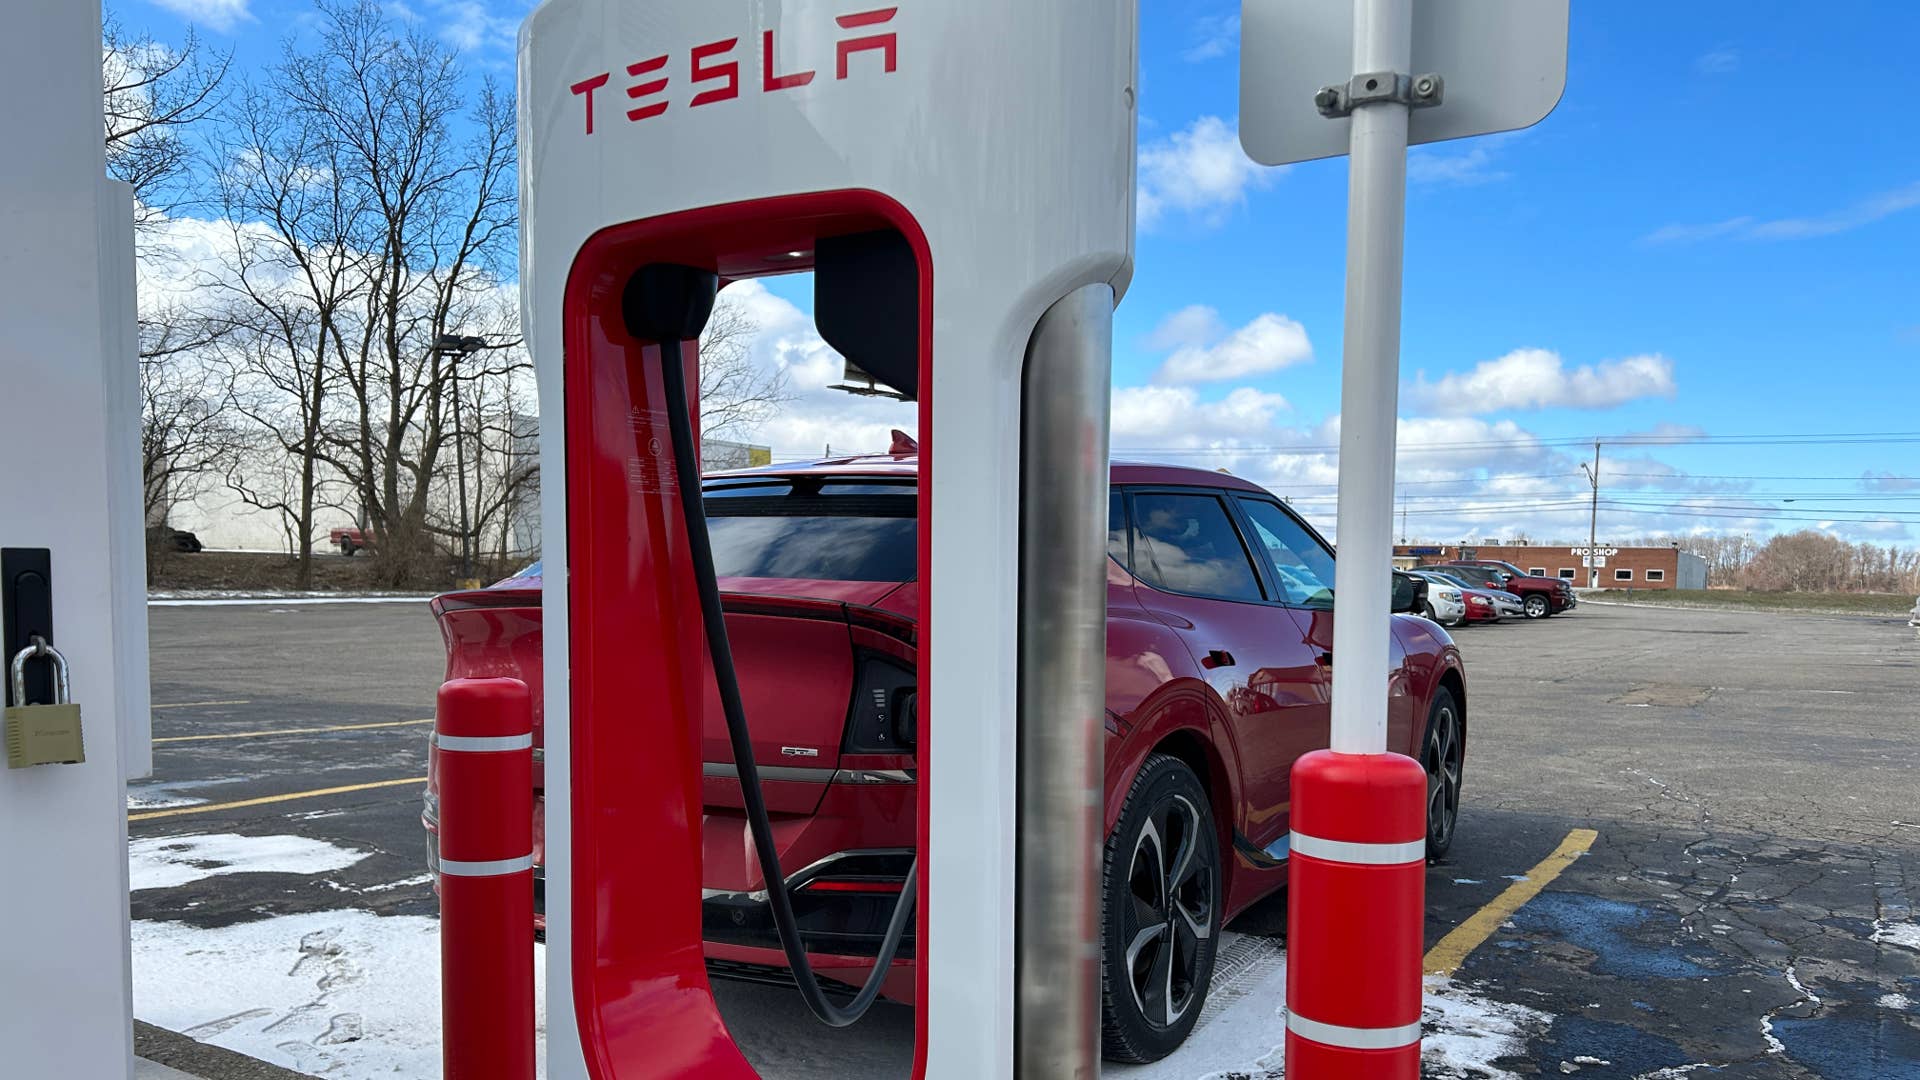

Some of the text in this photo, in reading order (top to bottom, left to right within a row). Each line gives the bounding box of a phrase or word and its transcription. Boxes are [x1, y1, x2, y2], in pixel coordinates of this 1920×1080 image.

[570, 7, 898, 135] TESLA
[1571, 548, 1618, 556] PRO SHOP
